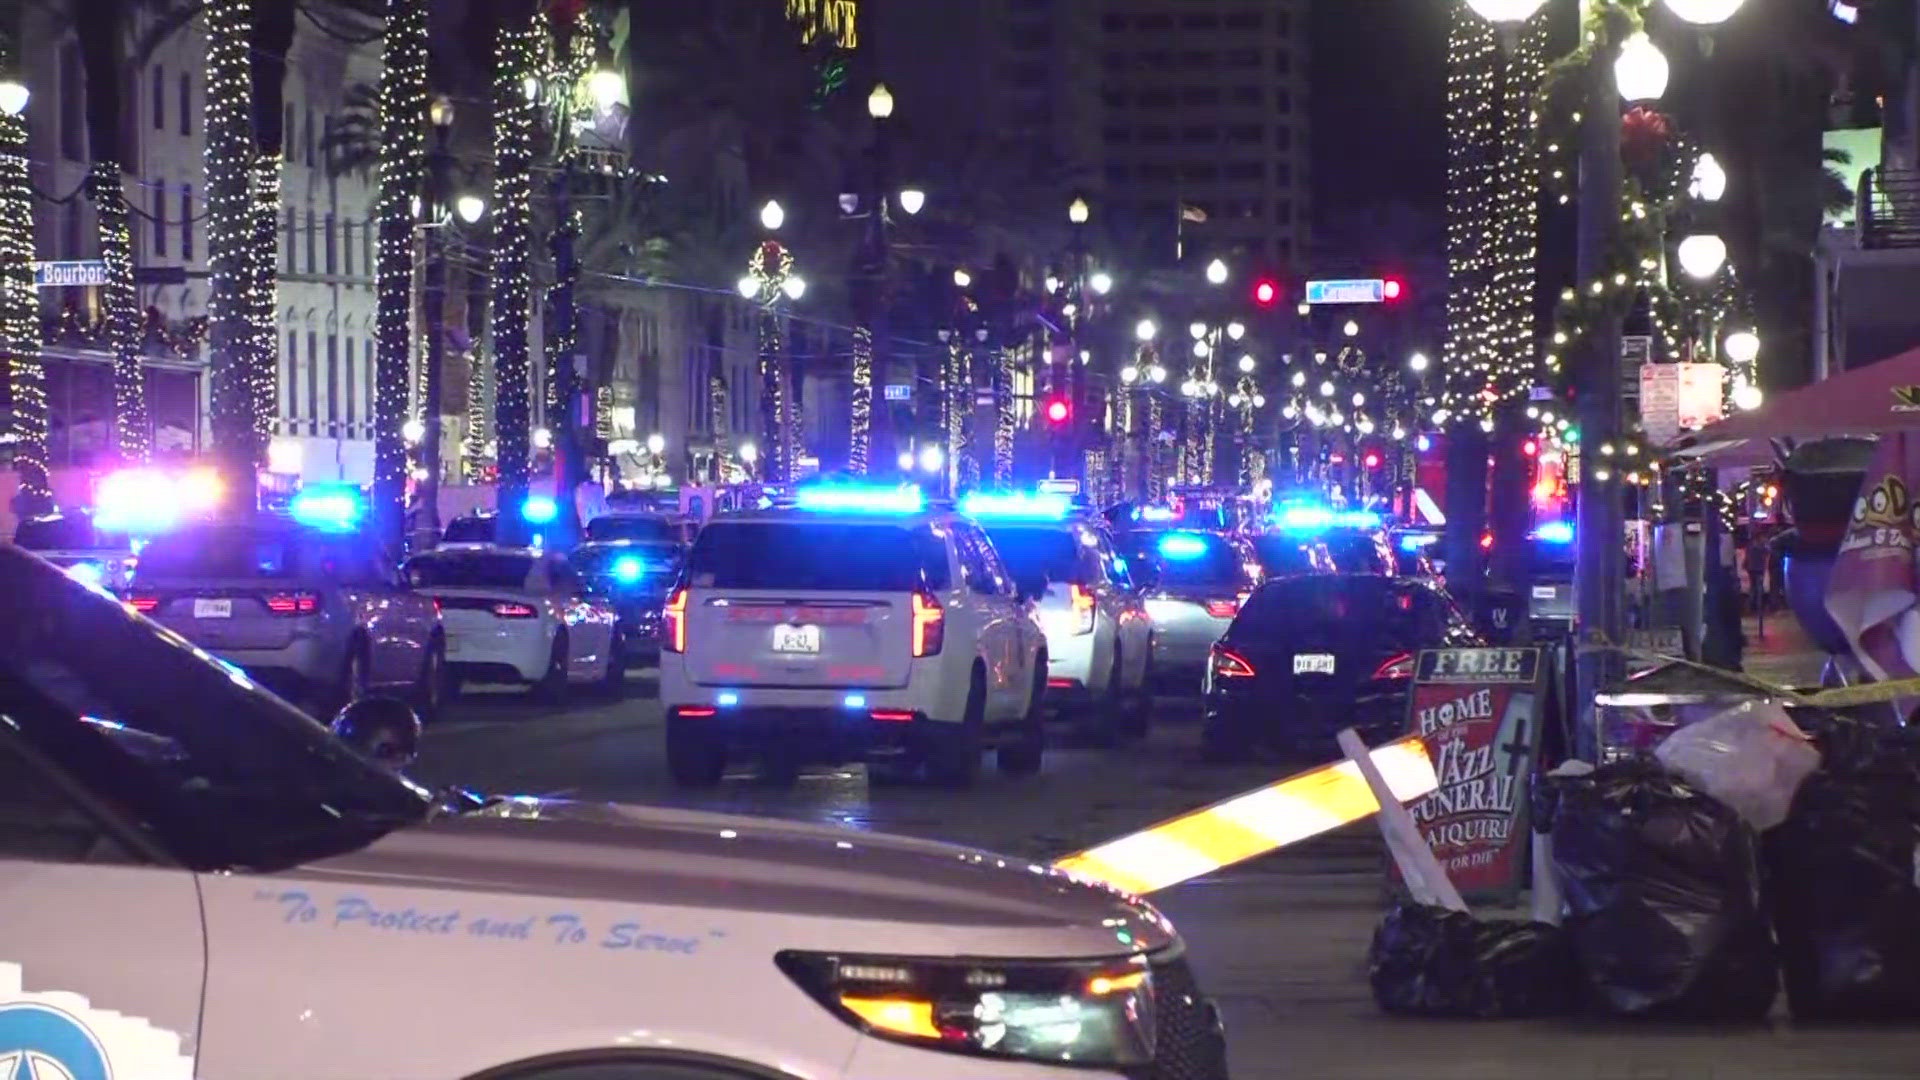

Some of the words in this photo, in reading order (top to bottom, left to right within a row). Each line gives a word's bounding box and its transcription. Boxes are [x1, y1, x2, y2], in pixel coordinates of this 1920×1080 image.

[1433, 651, 1522, 673] FREE
[1420, 688, 1492, 737] HOME
[1411, 775, 1514, 821] FUNERAL
[1427, 819, 1509, 847] AIQUIRI
[334, 898, 460, 933] Protect
[468, 915, 538, 941] and
[547, 914, 587, 943] To
